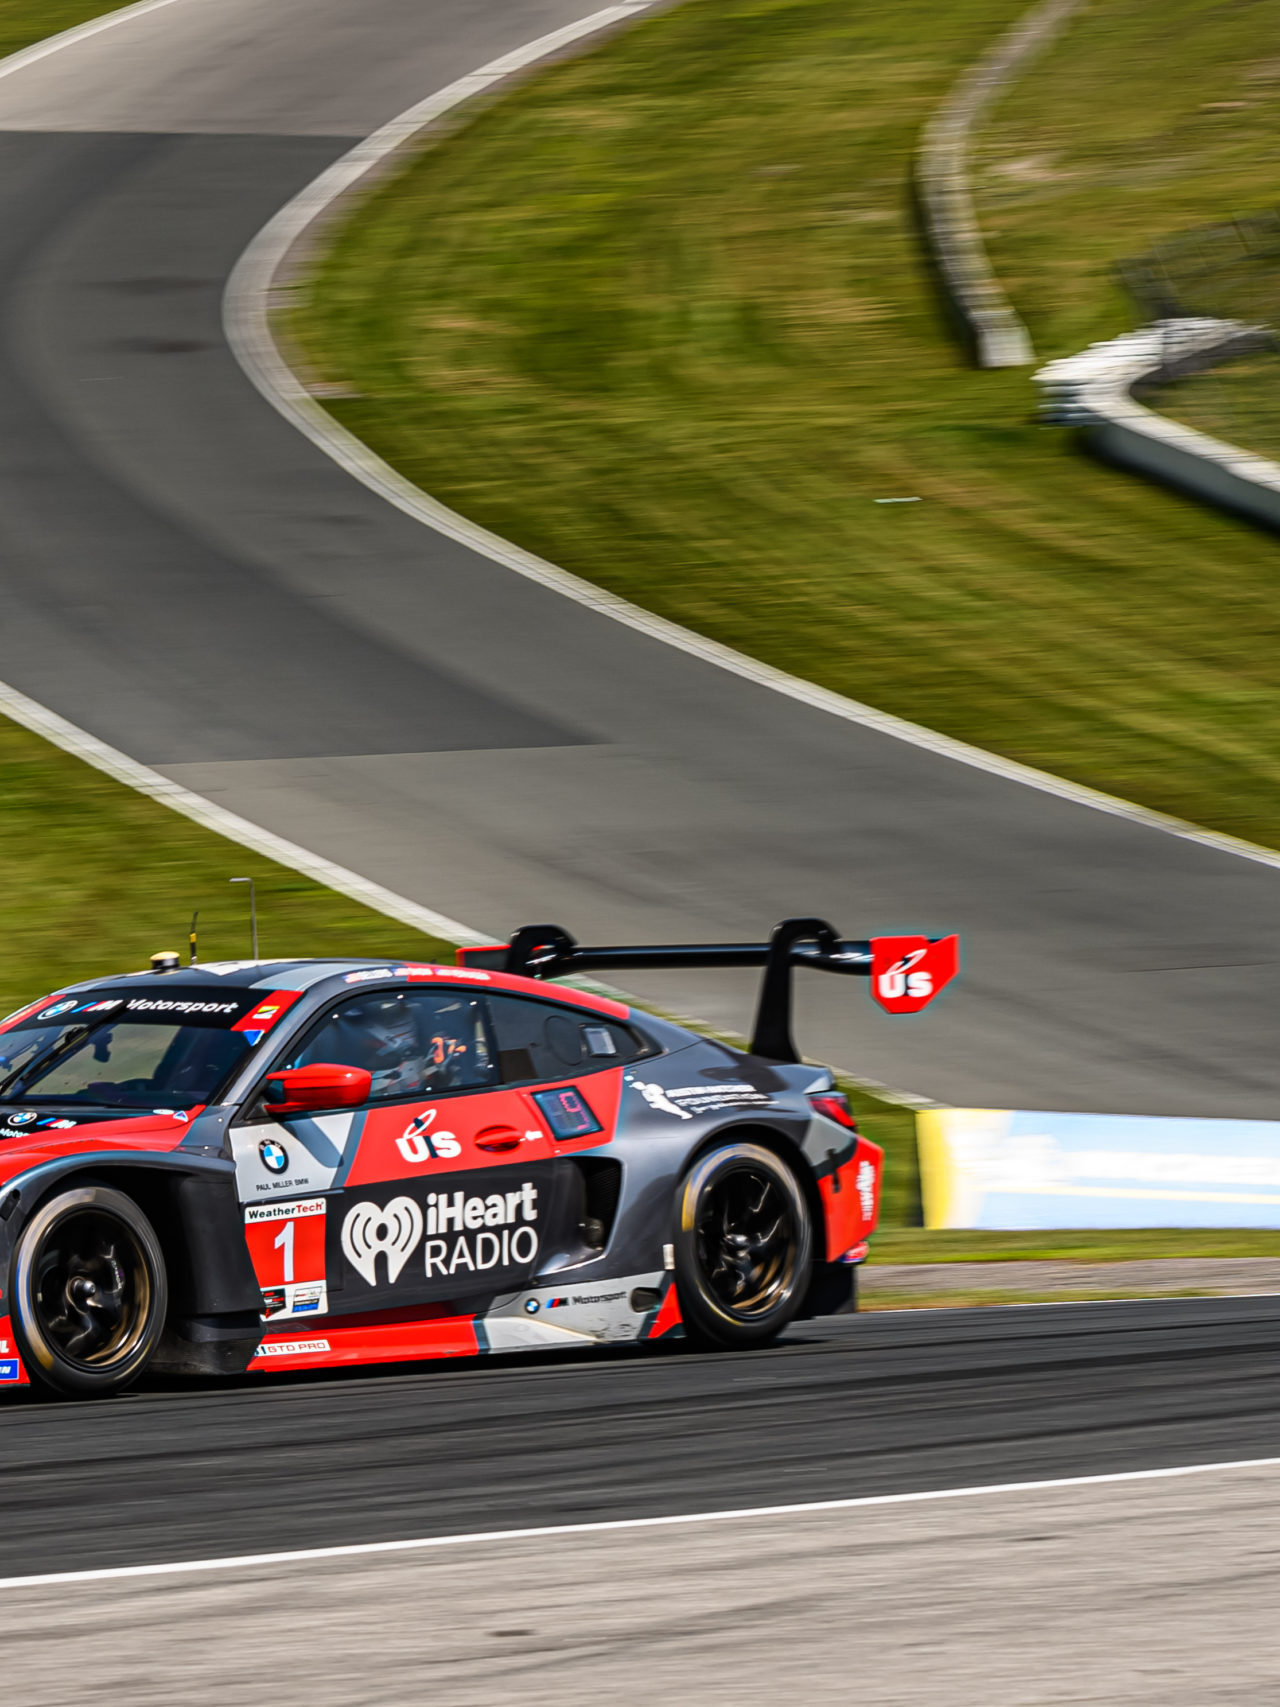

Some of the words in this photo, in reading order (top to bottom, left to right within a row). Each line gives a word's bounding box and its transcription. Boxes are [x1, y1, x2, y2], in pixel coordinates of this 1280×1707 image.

[126, 999, 239, 1013] Motorsport
[272, 1181, 293, 1189] MILLER
[294, 1178, 309, 1186] BMW
[248, 1202, 322, 1219] WeatherTech
[426, 1182, 538, 1235] iHeart
[274, 1221, 294, 1282] 1
[425, 1226, 538, 1278] RADIO
[571, 1291, 627, 1305] Motorsport
[267, 1345, 295, 1353] GTD
[298, 1342, 326, 1351] PRO
